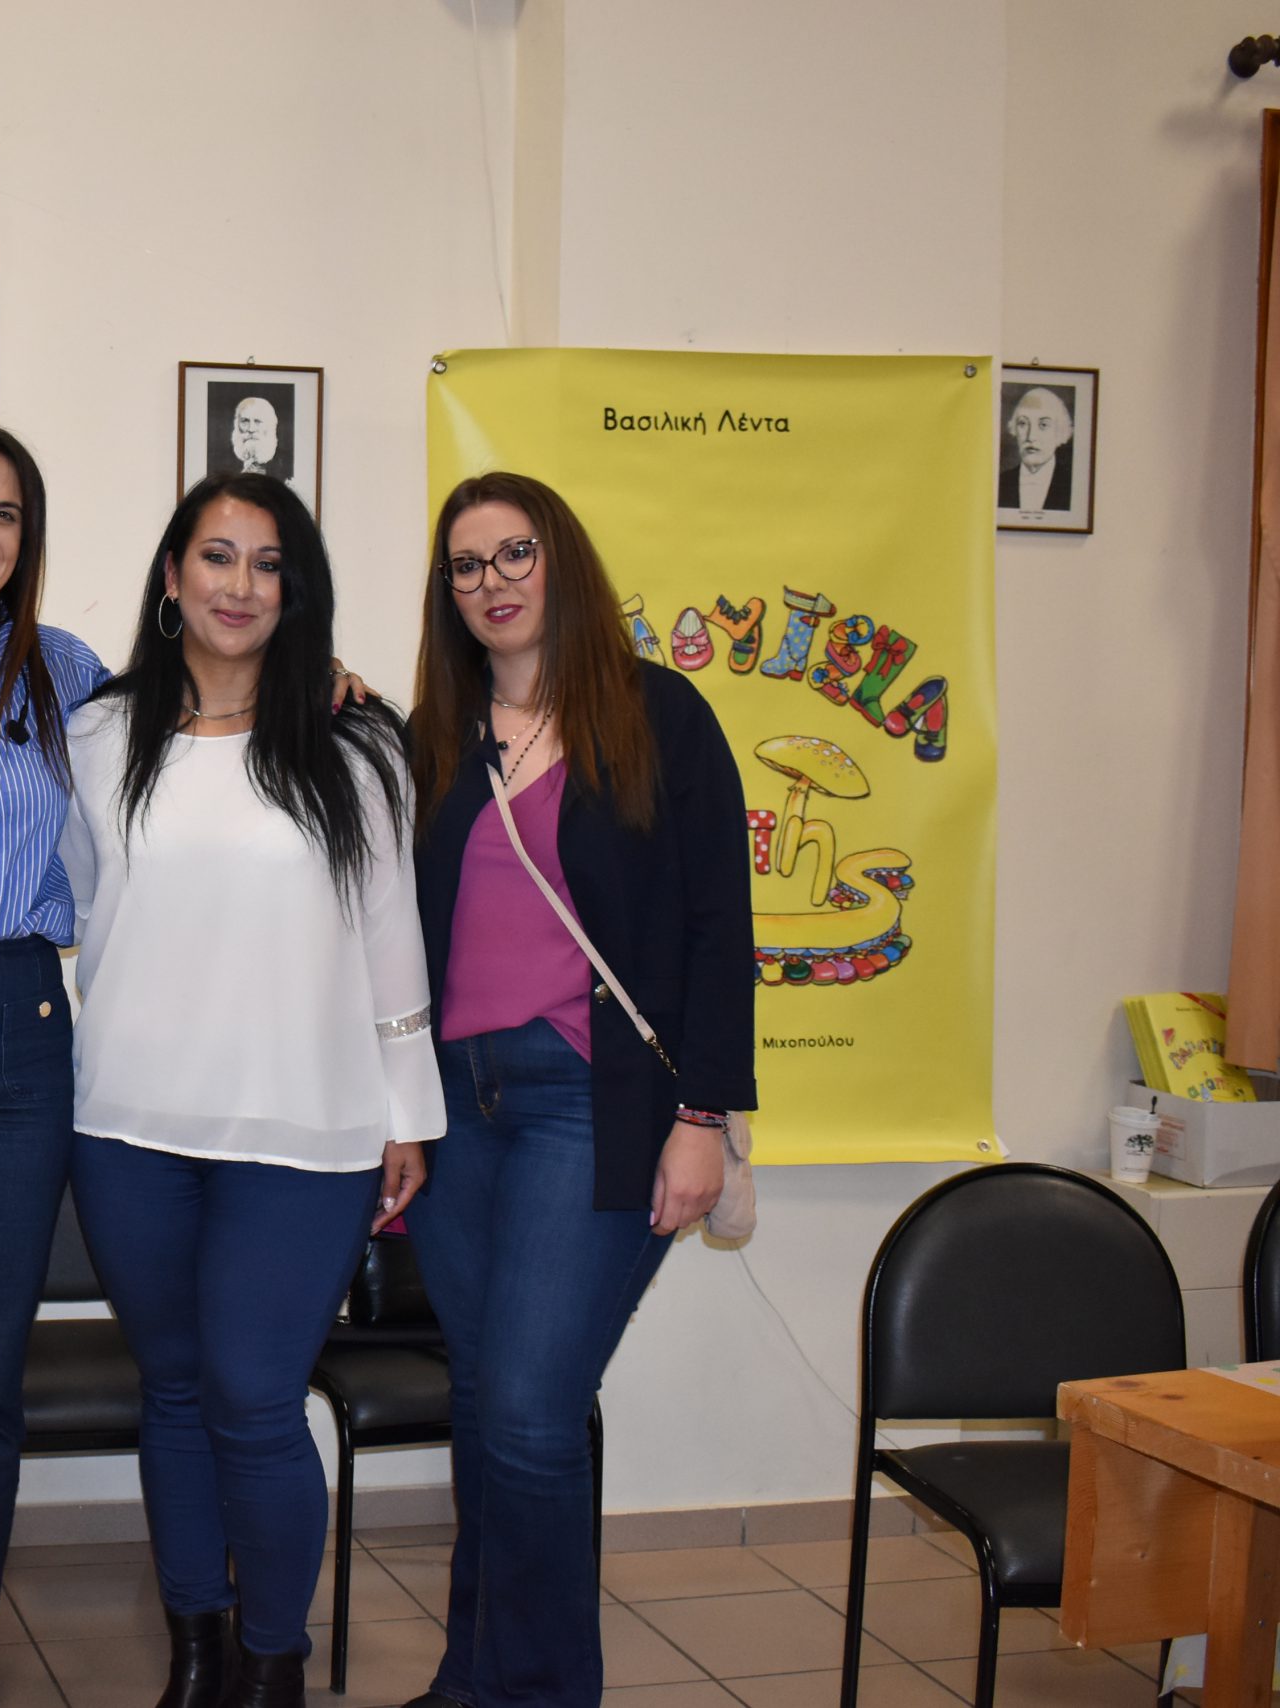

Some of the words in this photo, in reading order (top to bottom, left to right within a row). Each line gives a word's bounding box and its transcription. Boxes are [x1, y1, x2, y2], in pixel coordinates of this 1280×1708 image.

[603, 407, 706, 436] Βασιλική
[718, 409, 790, 433] Λέντα
[762, 1034, 855, 1050] Μιχοπούλου
